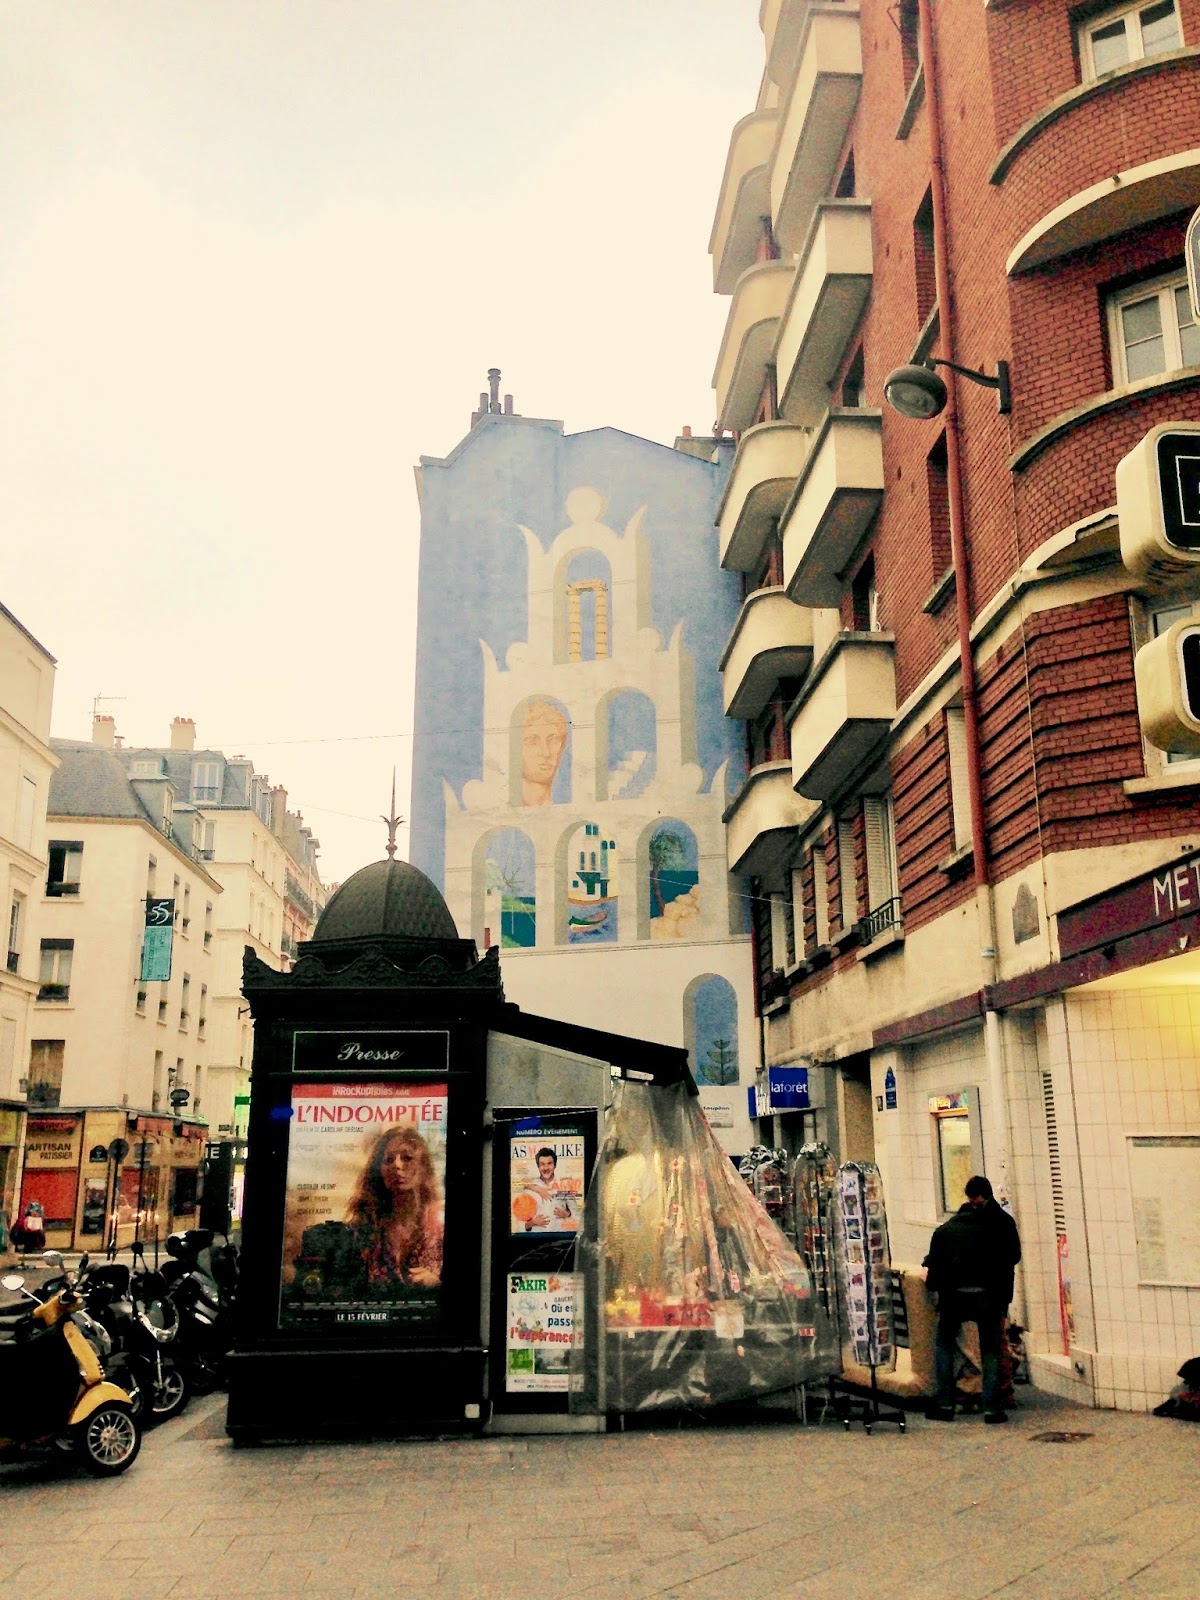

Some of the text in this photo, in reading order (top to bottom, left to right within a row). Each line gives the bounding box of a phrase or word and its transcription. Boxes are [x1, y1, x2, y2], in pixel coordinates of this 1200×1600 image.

[150, 901, 170, 925] 55
[337, 1042, 404, 1060] Presse
[770, 1080, 808, 1093] laforêt
[297, 1100, 443, 1123] L'INDOMPTÉE
[29, 1143, 72, 1151] ARTISAN
[512, 1145, 527, 1158] AS
[553, 1143, 583, 1157] LIKE
[551, 1303, 563, 1313] Où
[337, 1313, 345, 1321] LE
[347, 1313, 356, 1321] 15
[357, 1311, 387, 1321] FÉVRIER
